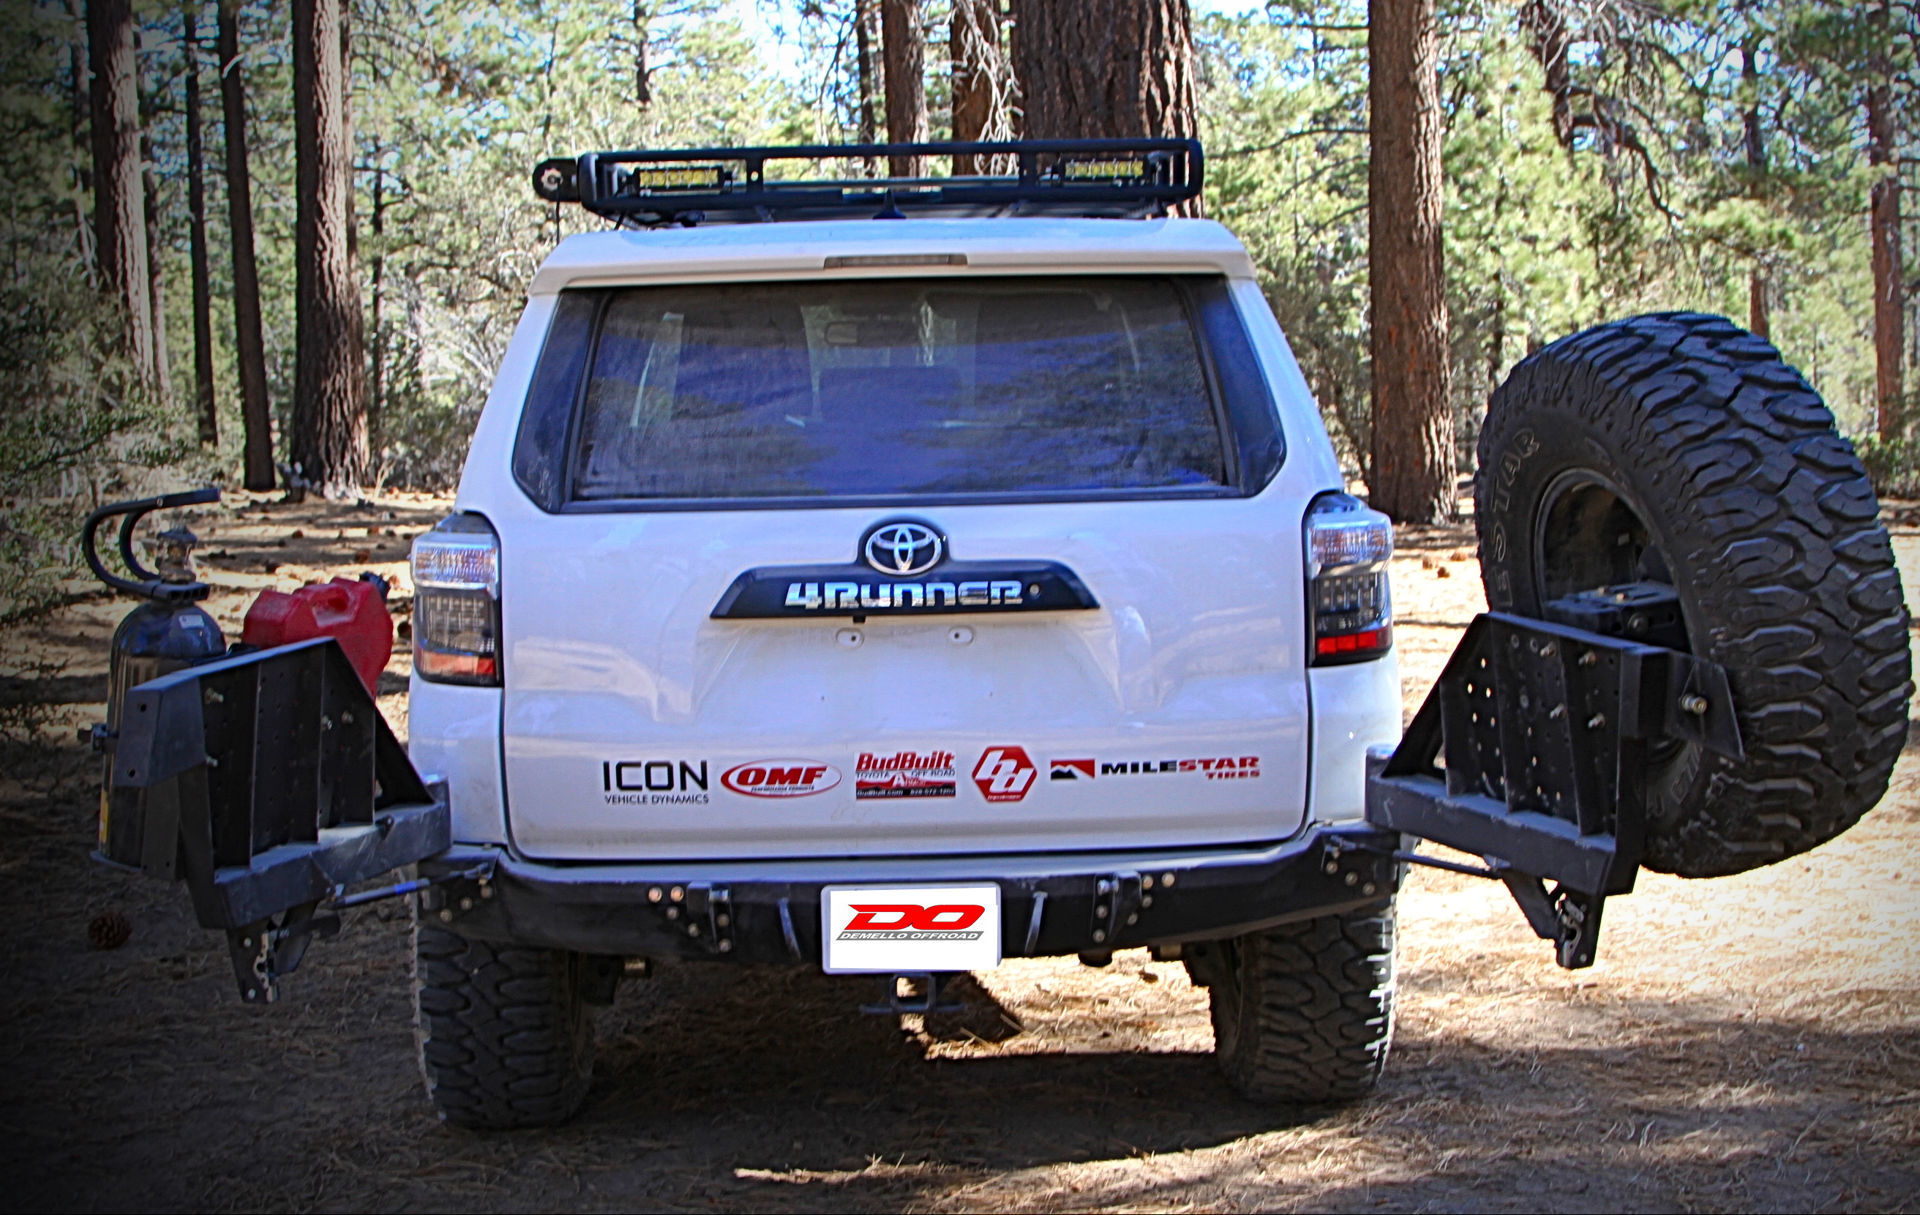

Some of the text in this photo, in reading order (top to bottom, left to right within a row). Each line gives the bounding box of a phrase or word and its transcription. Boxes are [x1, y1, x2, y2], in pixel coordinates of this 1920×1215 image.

[784, 580, 1024, 610] 4RUNNER
[856, 751, 955, 771] BudBuilt
[1101, 756, 1260, 775] MILESTAR
[603, 760, 708, 791] ICON
[736, 767, 828, 786] OMF
[856, 771, 891, 780] TOYOTA
[1206, 769, 1260, 780] TIRES
[604, 794, 709, 805] VEHICLE DYNAMICS
[844, 904, 985, 930] DO
[840, 932, 978, 940] DEMELLO OFFROAD
